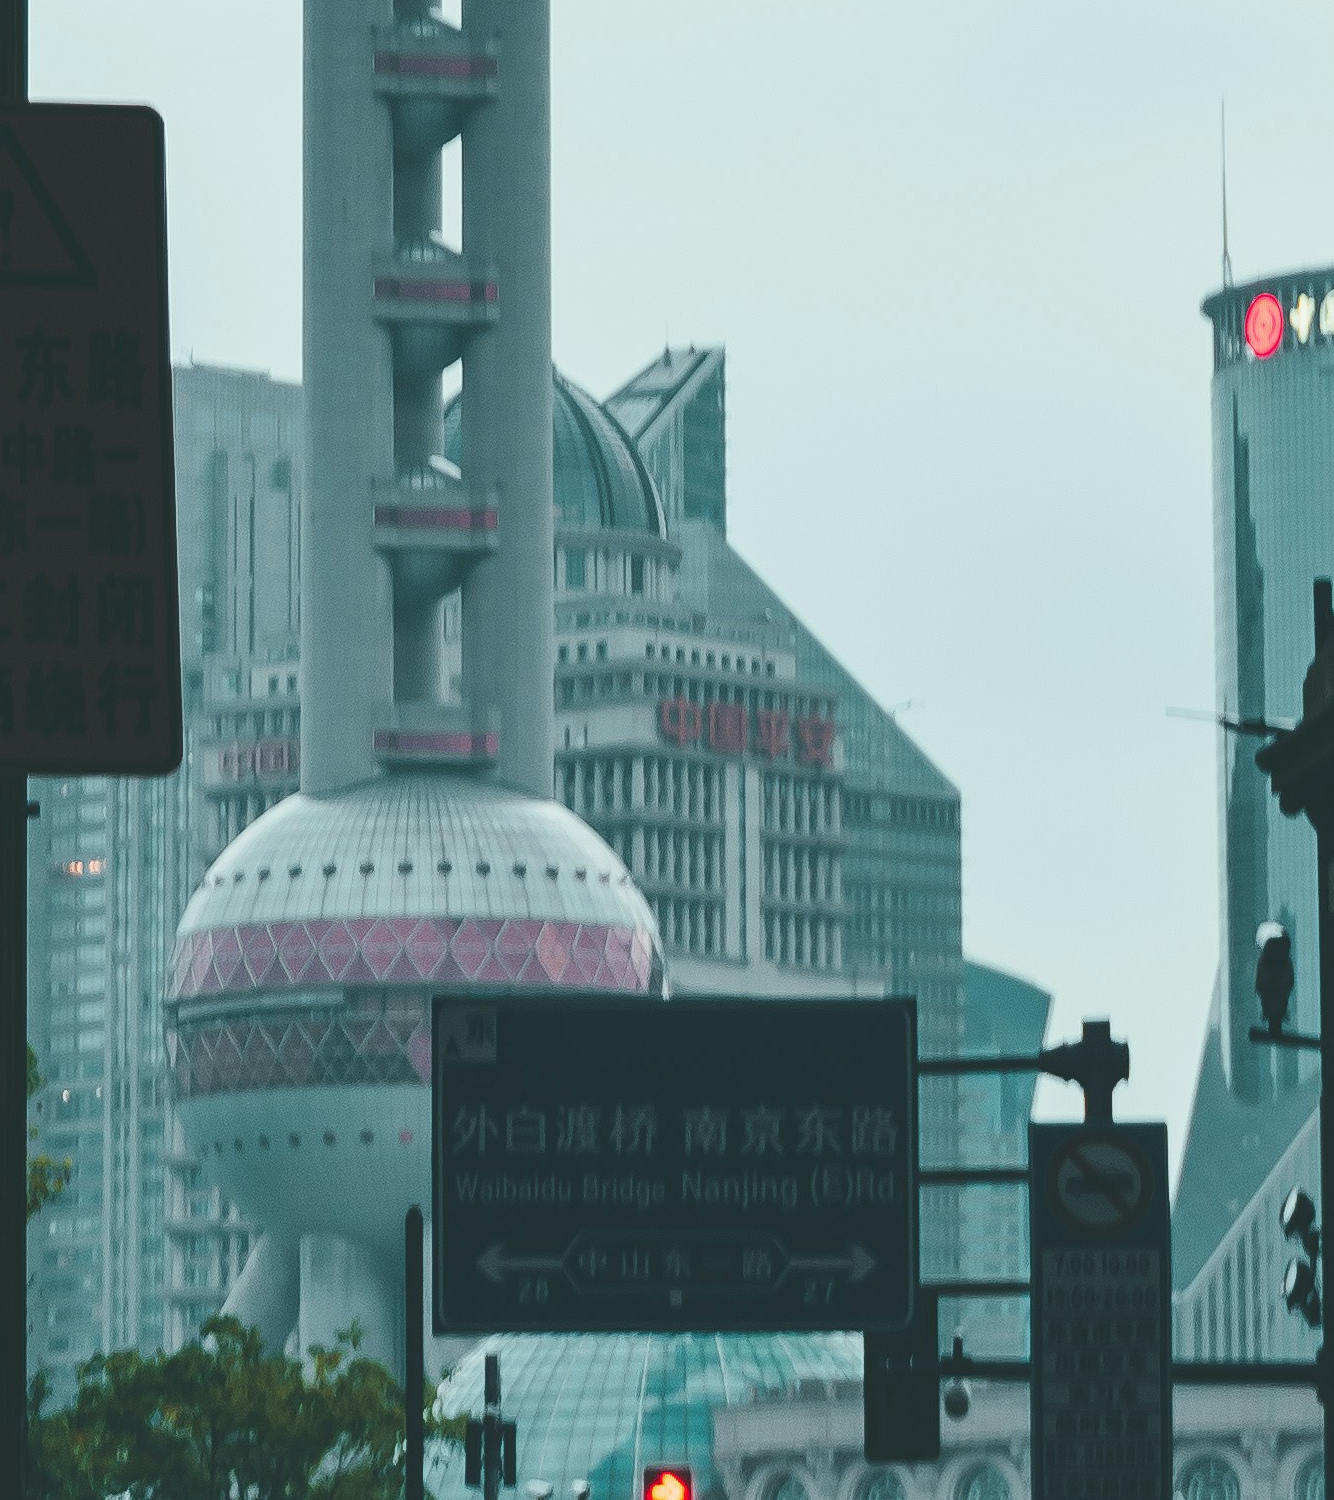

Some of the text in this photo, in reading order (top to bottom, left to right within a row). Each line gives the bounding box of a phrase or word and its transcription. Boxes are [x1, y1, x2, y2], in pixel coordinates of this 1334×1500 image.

[662, 696, 834, 769] 中国平安
[452, 1104, 899, 1156] 外白渡桥 南京东路
[455, 1170, 571, 1202] Waibaidu
[582, 1170, 665, 1211] Bridge
[682, 1168, 798, 1213] Nanjing
[578, 1248, 771, 1280] 中山东一路
